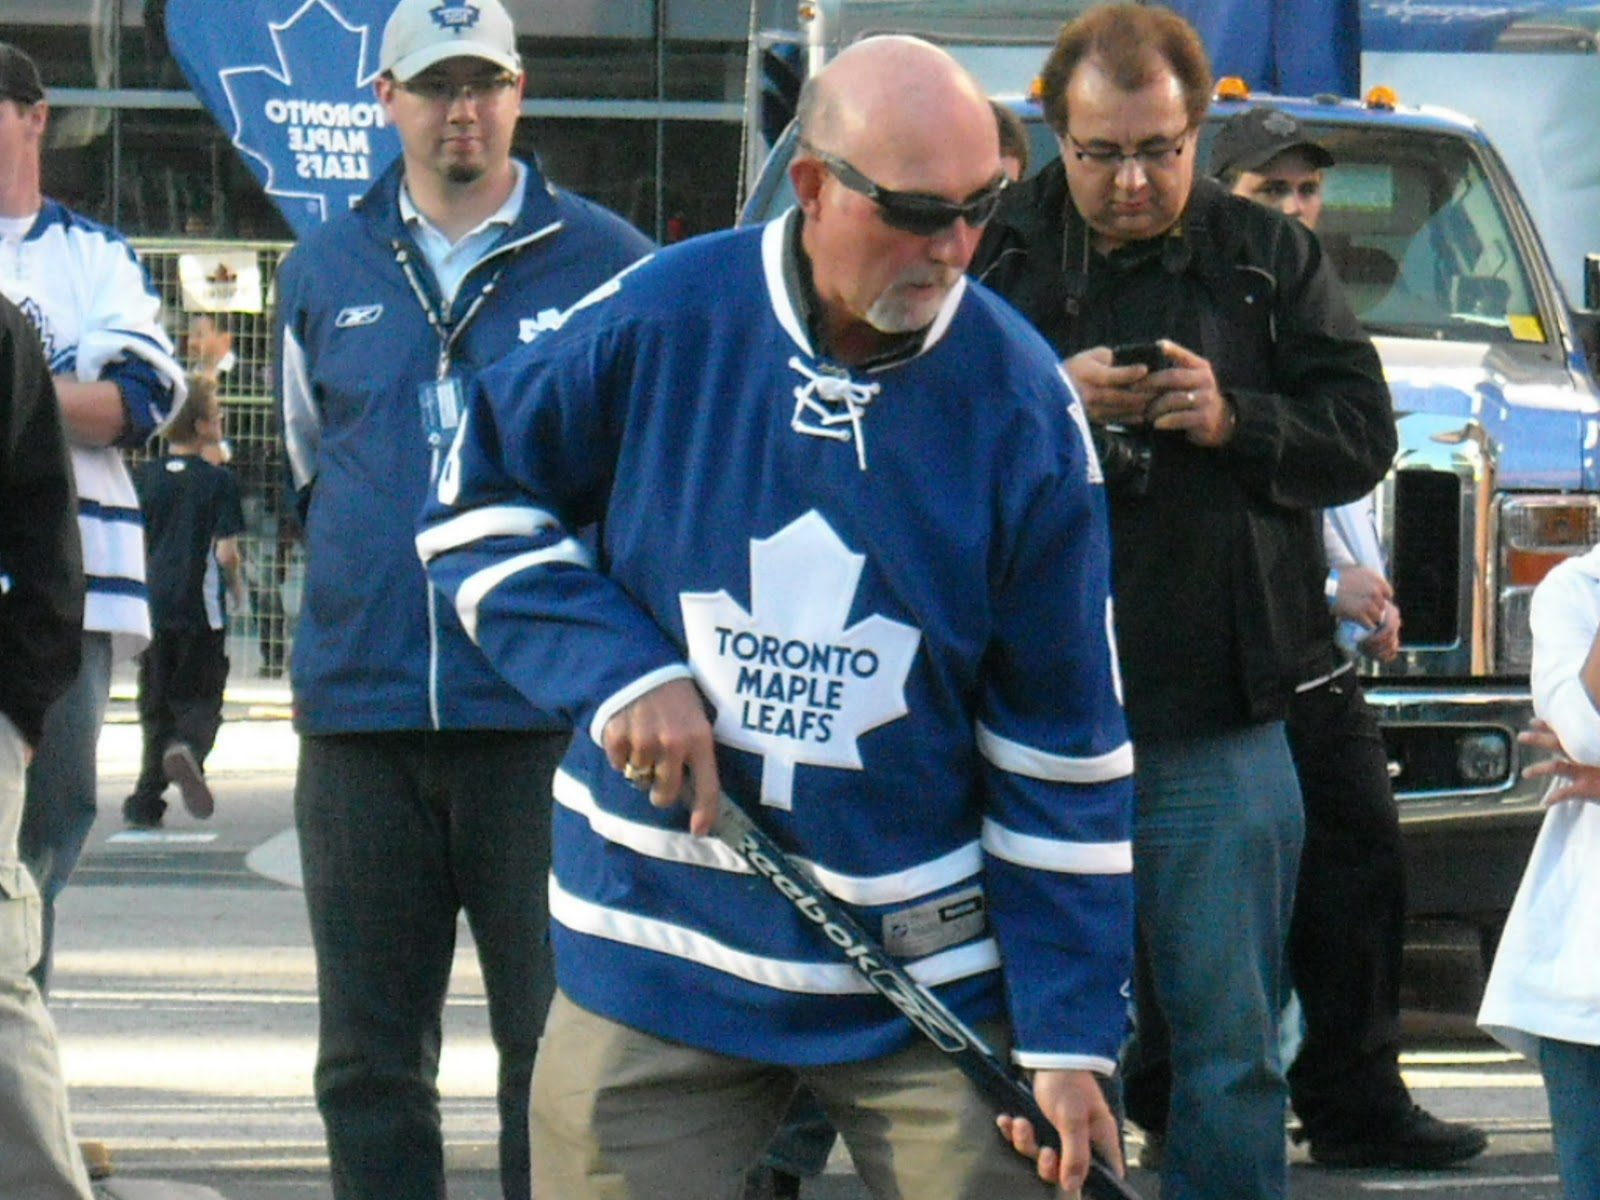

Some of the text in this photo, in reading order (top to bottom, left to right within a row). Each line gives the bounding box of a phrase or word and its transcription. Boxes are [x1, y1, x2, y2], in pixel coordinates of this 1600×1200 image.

[714, 626, 879, 679] TORONTO
[735, 666, 844, 711] MAPLE
[740, 699, 834, 743] LEAFS
